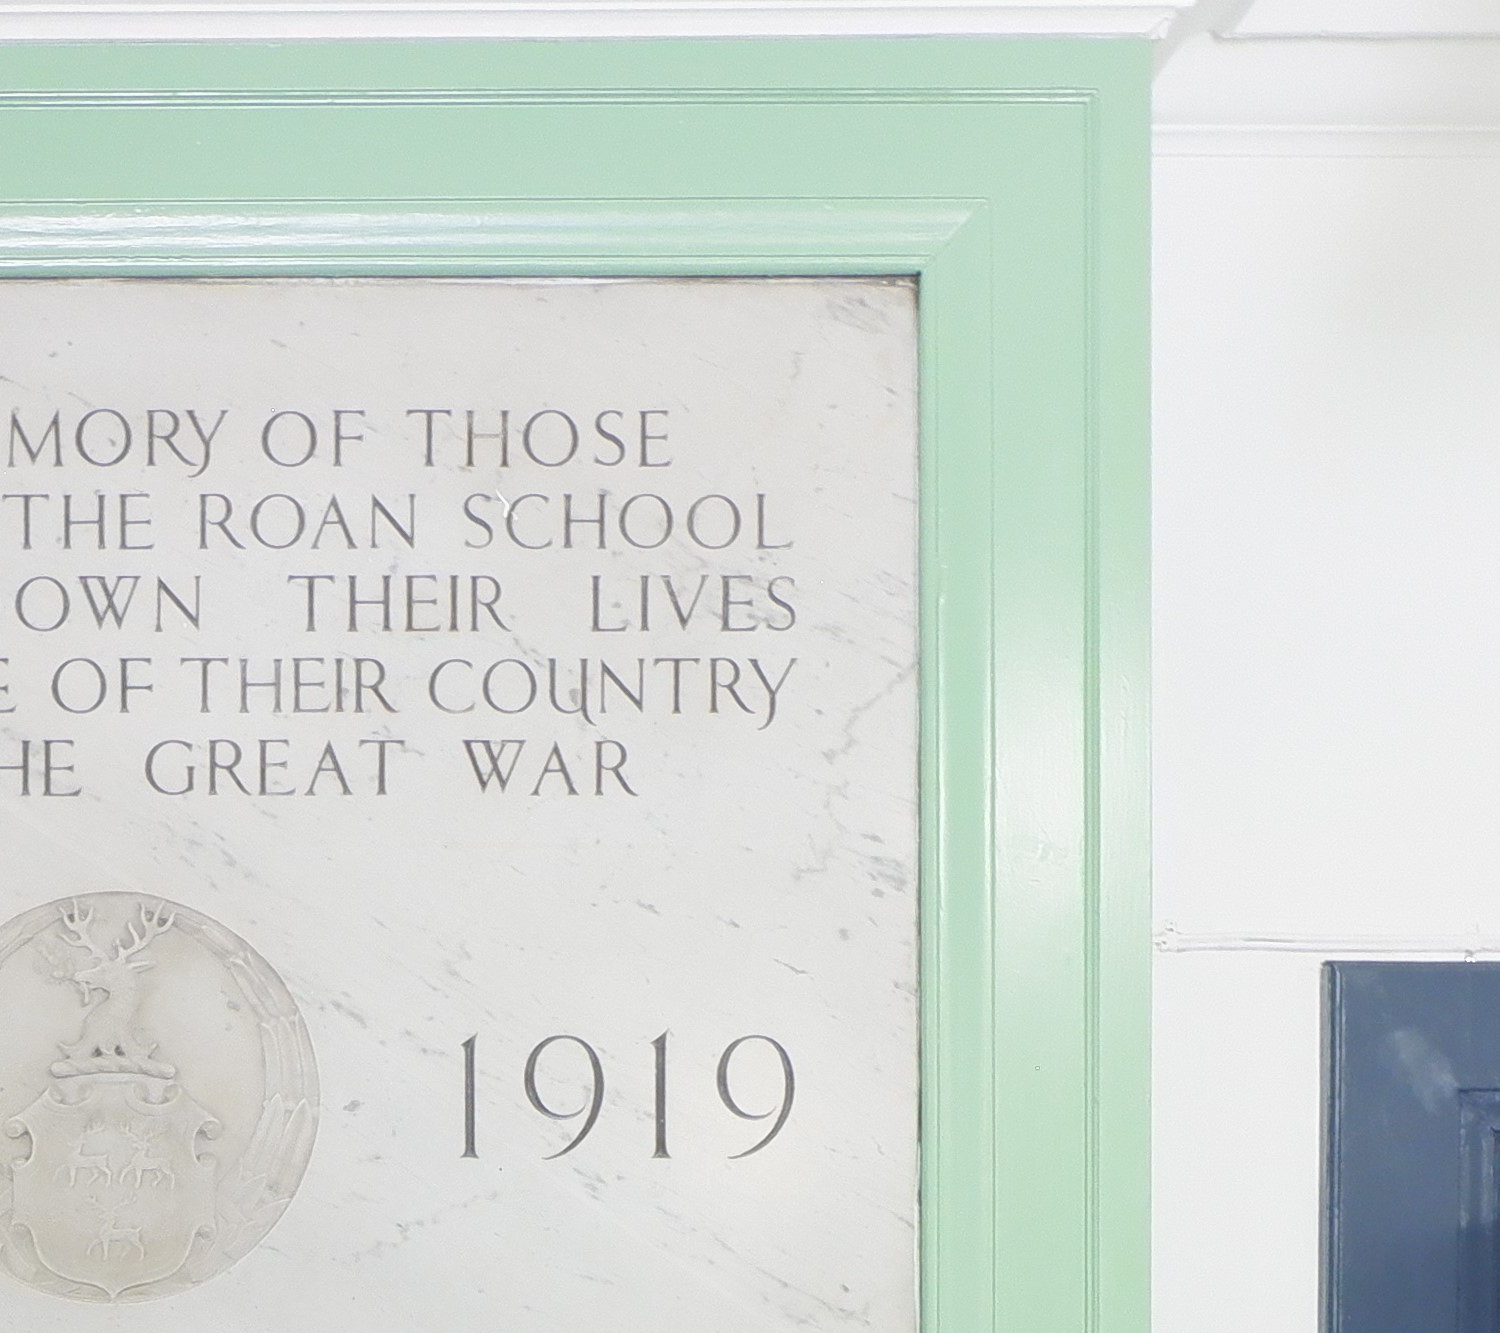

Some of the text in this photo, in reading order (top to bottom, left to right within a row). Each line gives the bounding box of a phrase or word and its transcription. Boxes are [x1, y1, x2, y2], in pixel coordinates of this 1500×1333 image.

[259, 409, 368, 470] OF
[405, 408, 675, 470] THOSE
[1, 491, 158, 552] THE
[196, 491, 423, 552] ROAN
[461, 490, 795, 554] SCHOOL
[284, 573, 509, 634] THEIR
[587, 573, 798, 634] LIVES
[48, 655, 158, 716] OF
[179, 655, 398, 716] THEIR
[426, 655, 798, 729] COUNTRY
[144, 738, 407, 798] GREAT
[462, 738, 639, 798] WAR
[459, 1030, 798, 1161] 1919
